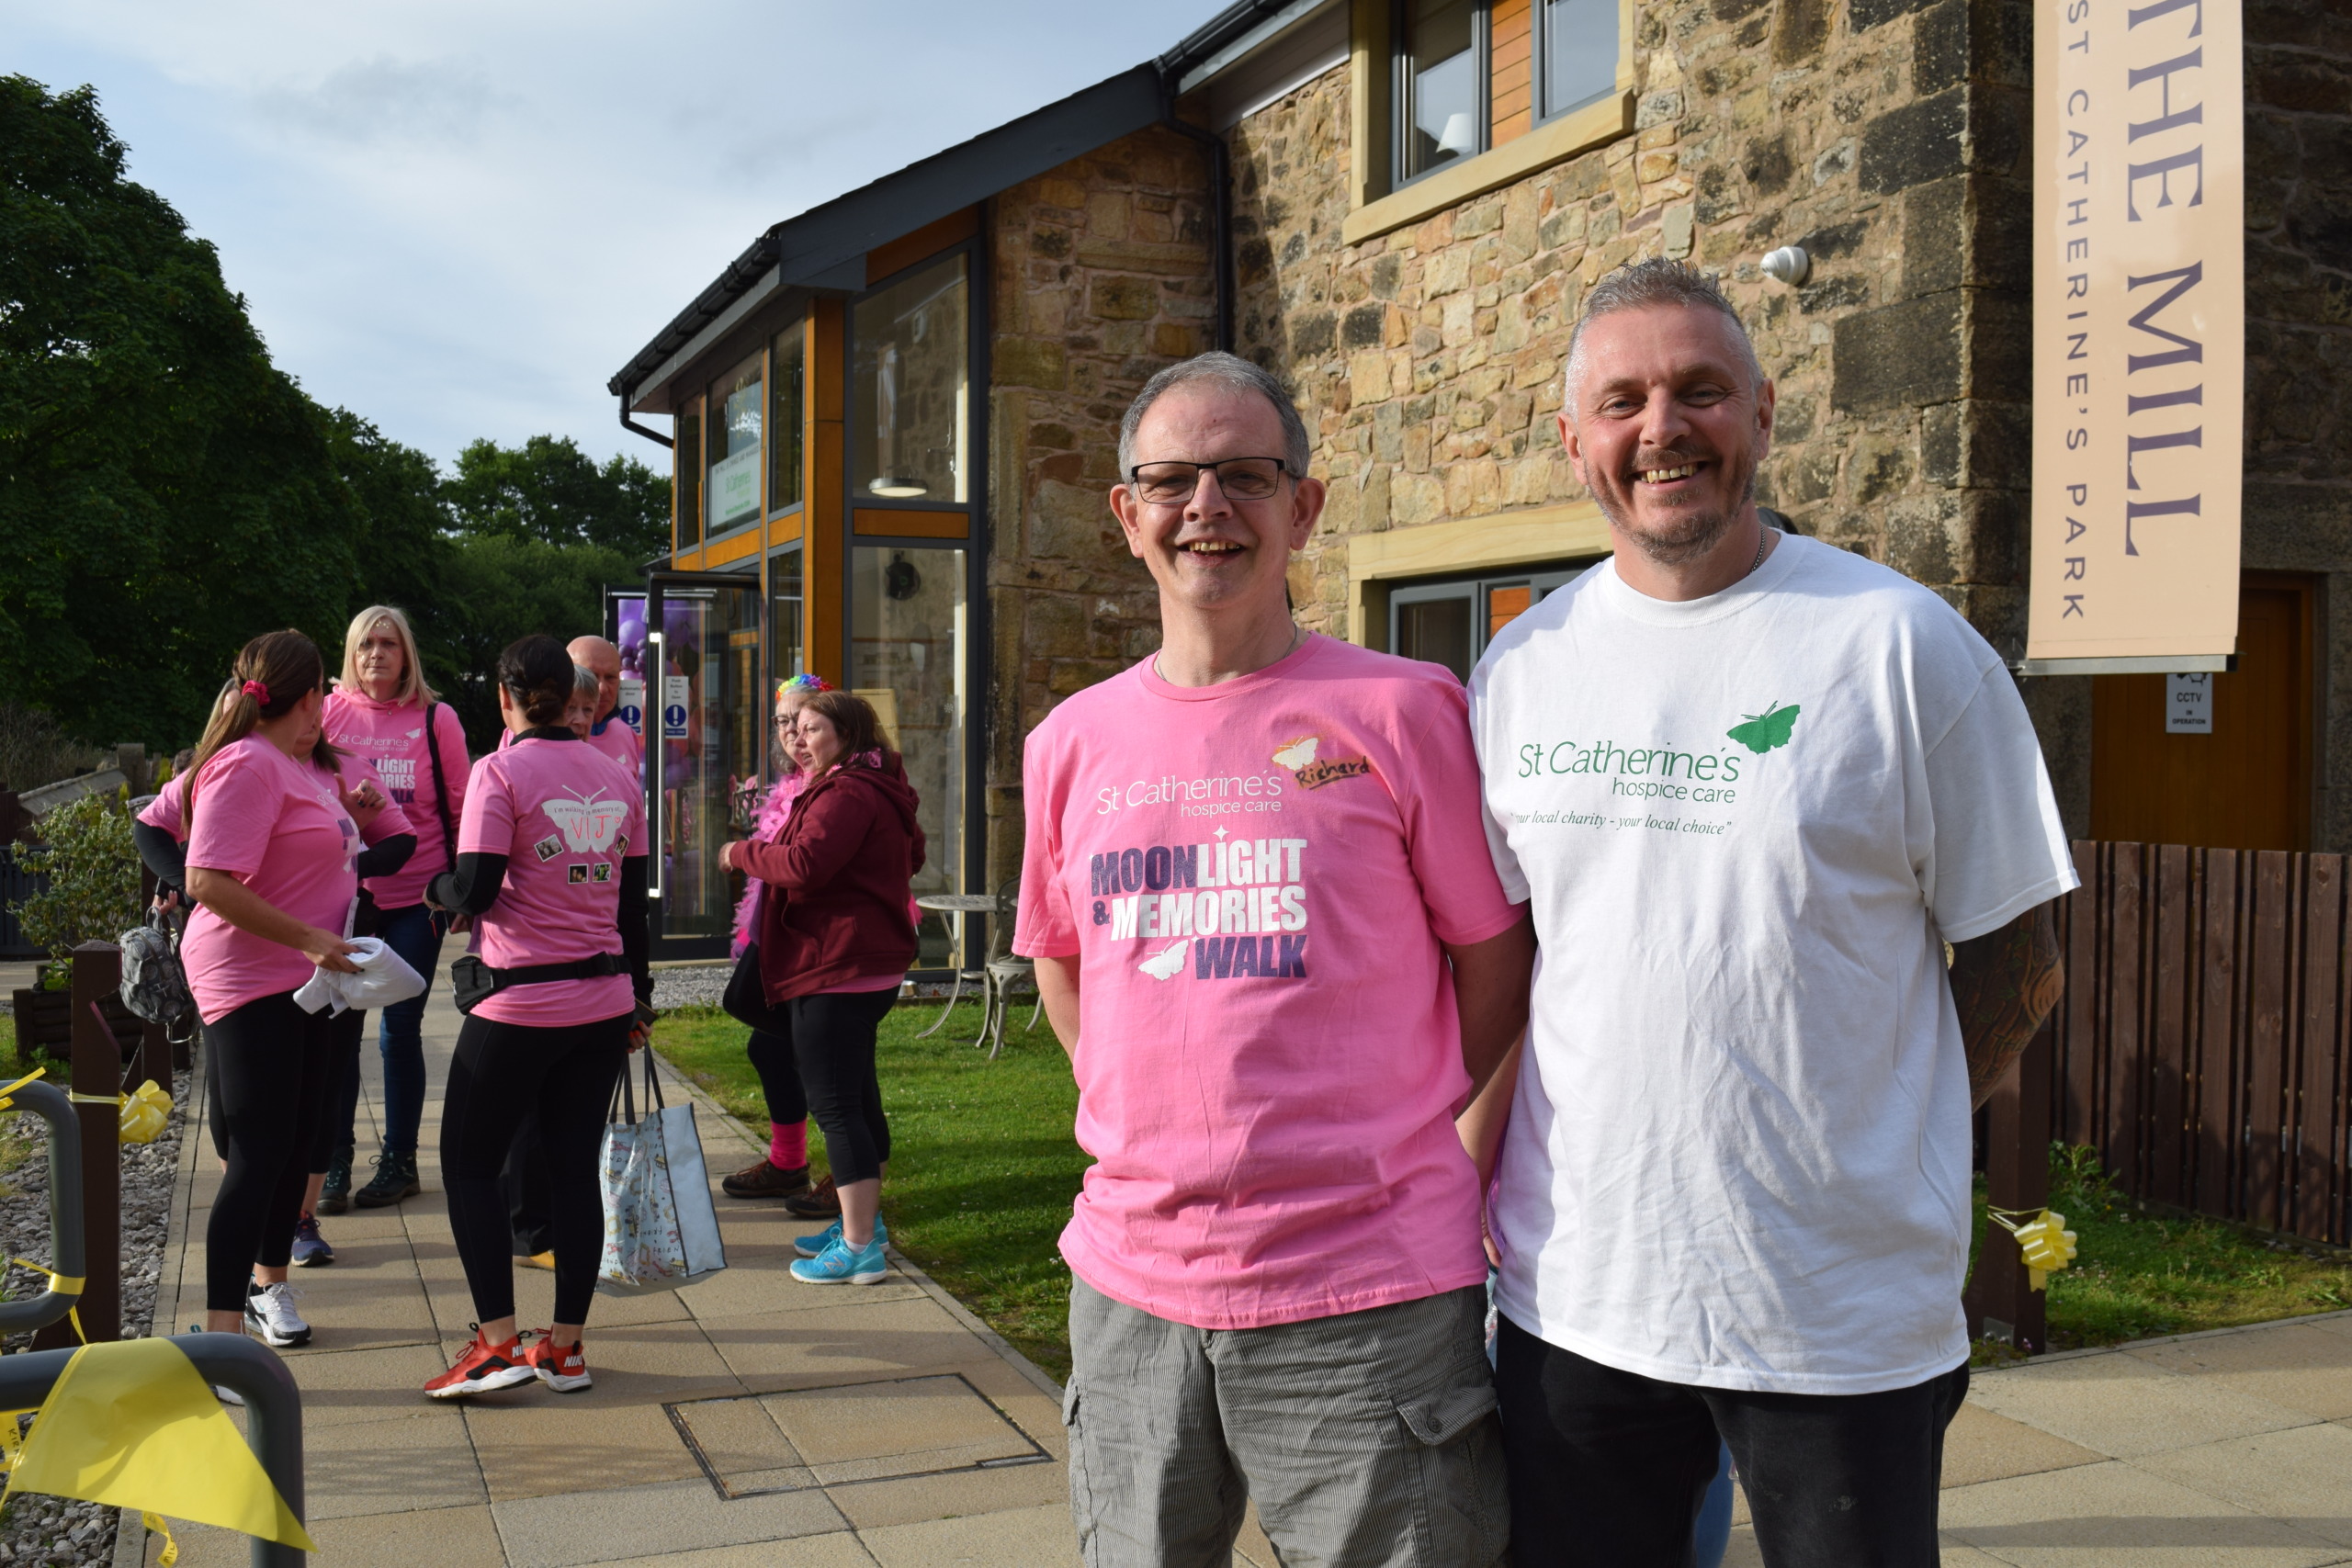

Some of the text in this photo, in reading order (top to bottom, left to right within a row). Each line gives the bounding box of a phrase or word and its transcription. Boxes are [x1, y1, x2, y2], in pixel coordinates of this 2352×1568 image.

[2125, 0, 2202, 556] THE MILL
[2063, 0, 2088, 619] ST CATHERINE'S PARK
[2177, 692, 2202, 703] CCTV
[339, 734, 409, 747] St Catherine's
[1295, 755, 1371, 789] Richard
[1518, 739, 1741, 782] St Catherine's
[390, 789, 415, 803] ALK
[1097, 769, 1282, 815] St Catherine's
[1611, 777, 1736, 803] hospice care
[565, 806, 585, 816] walking
[1181, 798, 1282, 818] hospice care
[1532, 810, 1559, 824] local
[1561, 811, 1607, 829] charity
[1616, 817, 1643, 830] your
[1645, 815, 1680, 831] local
[1091, 838, 1307, 897] MOONLIGHT
[1092, 885, 1307, 941] & MEMORIES
[1194, 934, 1307, 980] WALK
